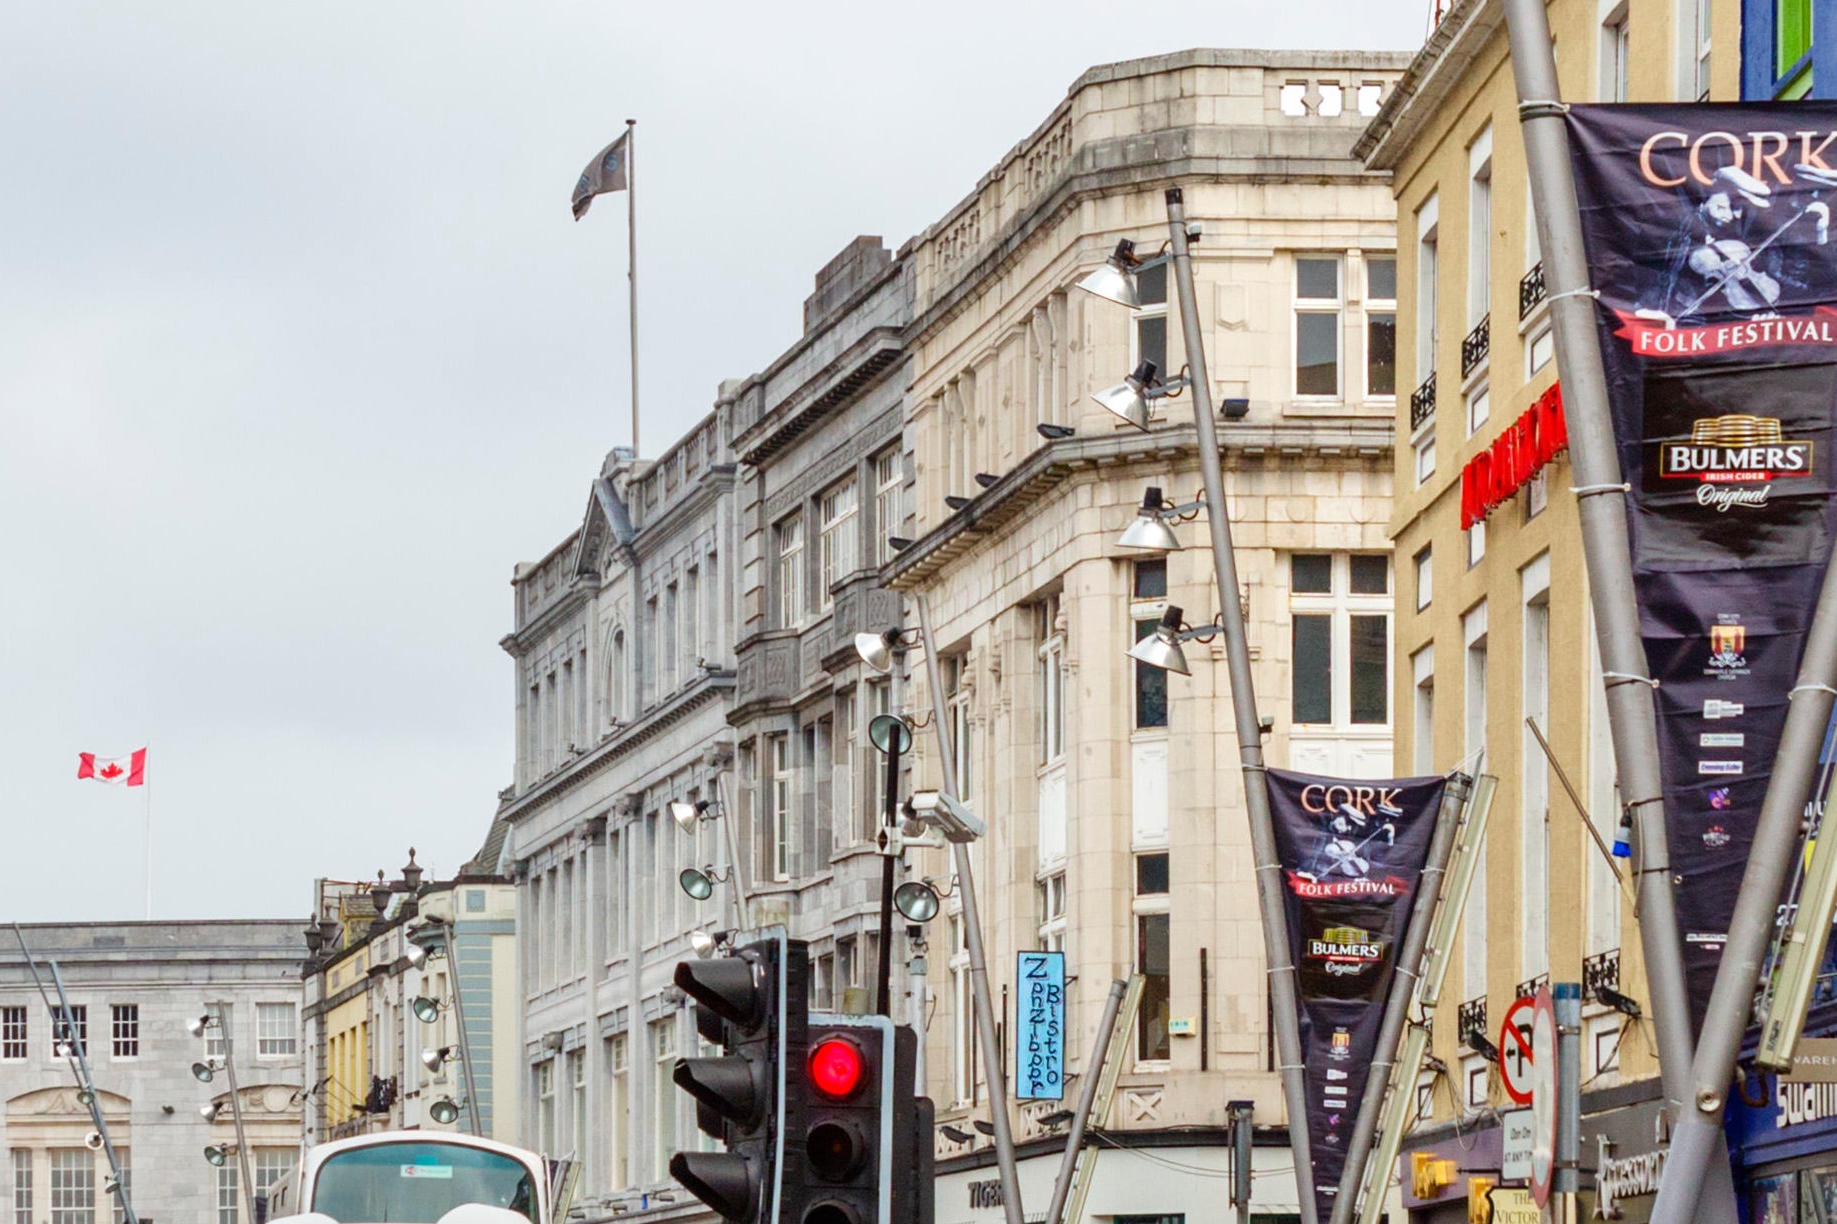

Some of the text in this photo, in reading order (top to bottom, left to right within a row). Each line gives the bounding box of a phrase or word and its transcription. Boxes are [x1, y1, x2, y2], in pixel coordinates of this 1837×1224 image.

[1640, 321, 1833, 352] FOLK FESTIVAL
[1670, 446, 1803, 471] BULMERS
[1705, 473, 1765, 481] IRISH CIDER
[1696, 483, 1772, 512] Original
[1301, 784, 1403, 816] CORK
[1299, 883, 1395, 895] FOLK FESTIVAL
[1312, 941, 1379, 957] BULMERS
